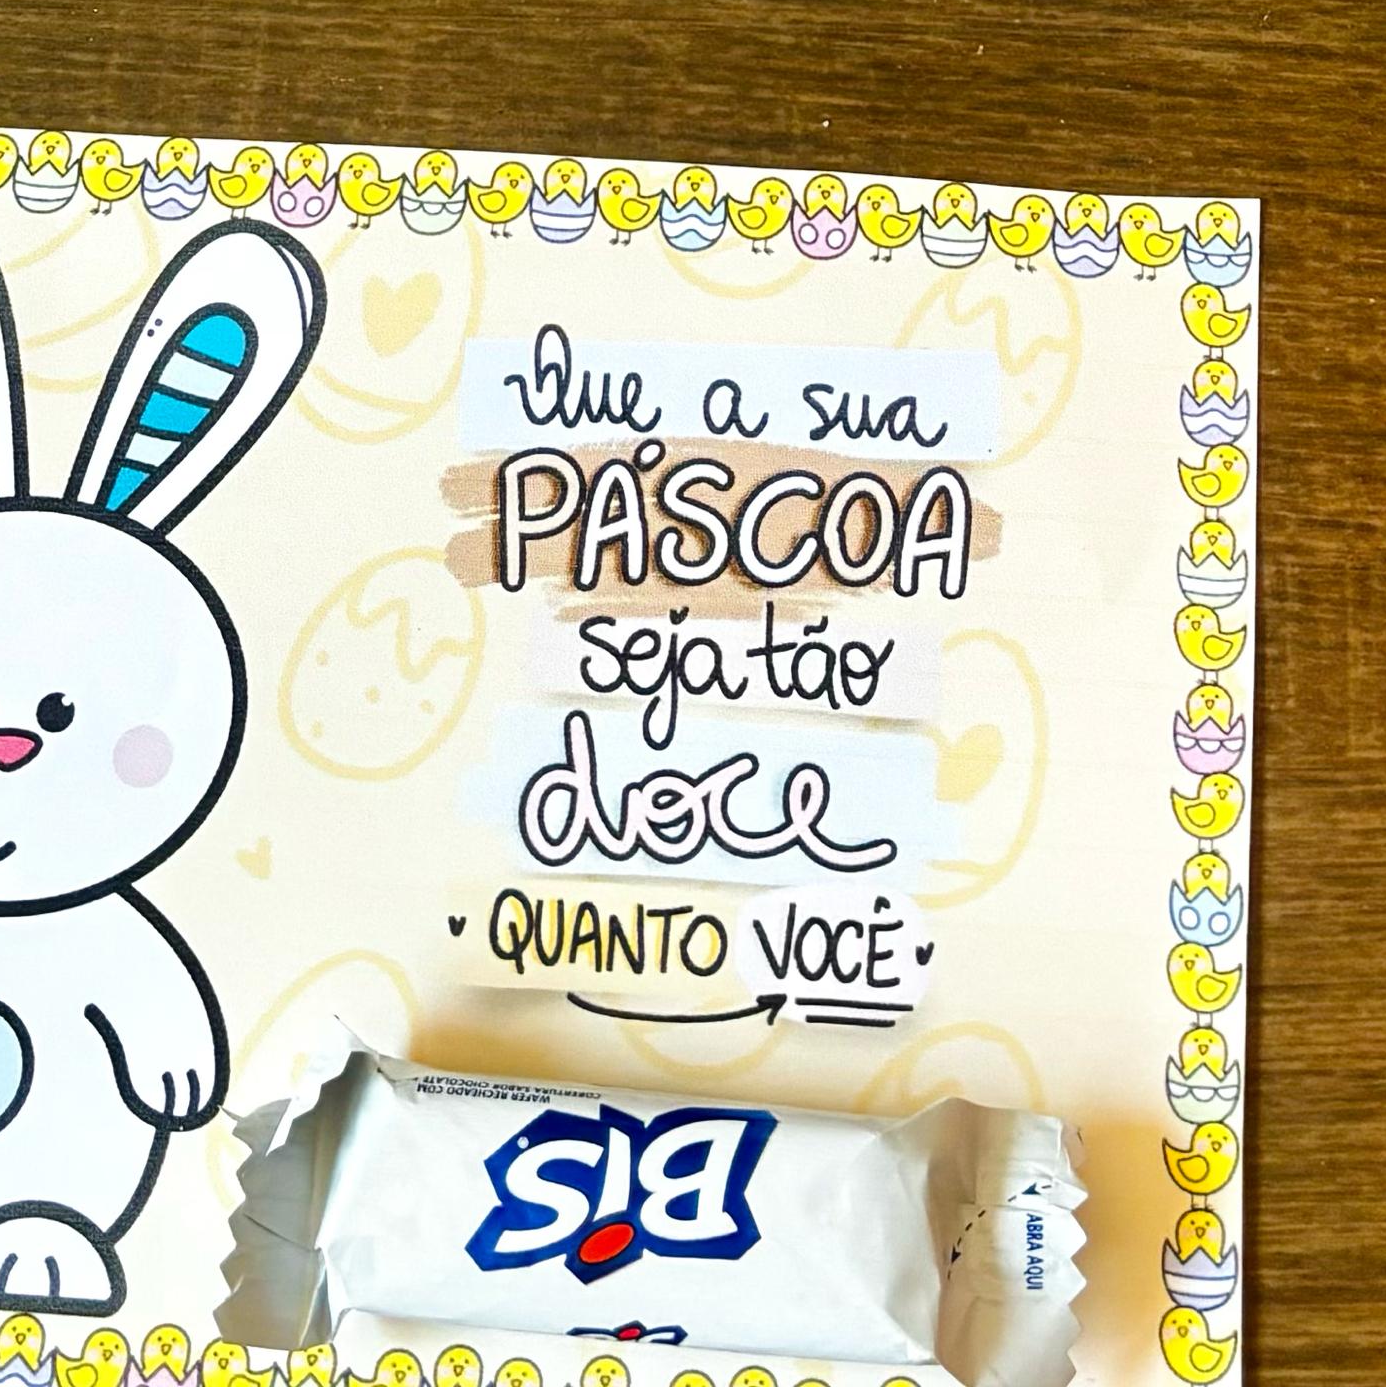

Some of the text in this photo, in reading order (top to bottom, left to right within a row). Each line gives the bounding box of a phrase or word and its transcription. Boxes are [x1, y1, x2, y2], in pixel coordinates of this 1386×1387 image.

[504, 323, 949, 449] Que a sua
[496, 437, 971, 601] PÁSCOA
[578, 600, 896, 751] seja tão
[518, 709, 899, 874] doce
[488, 887, 907, 990] QUANTO VOCÊ
[416, 1082, 551, 1105] WAFER RECHEADO COM
[421, 1075, 489, 1089] CHOCOLATE
[533, 1087, 602, 1101] COBERTURA
[492, 1118, 751, 1265] BIS
[1024, 1211, 1045, 1291] ABRA AQUI
